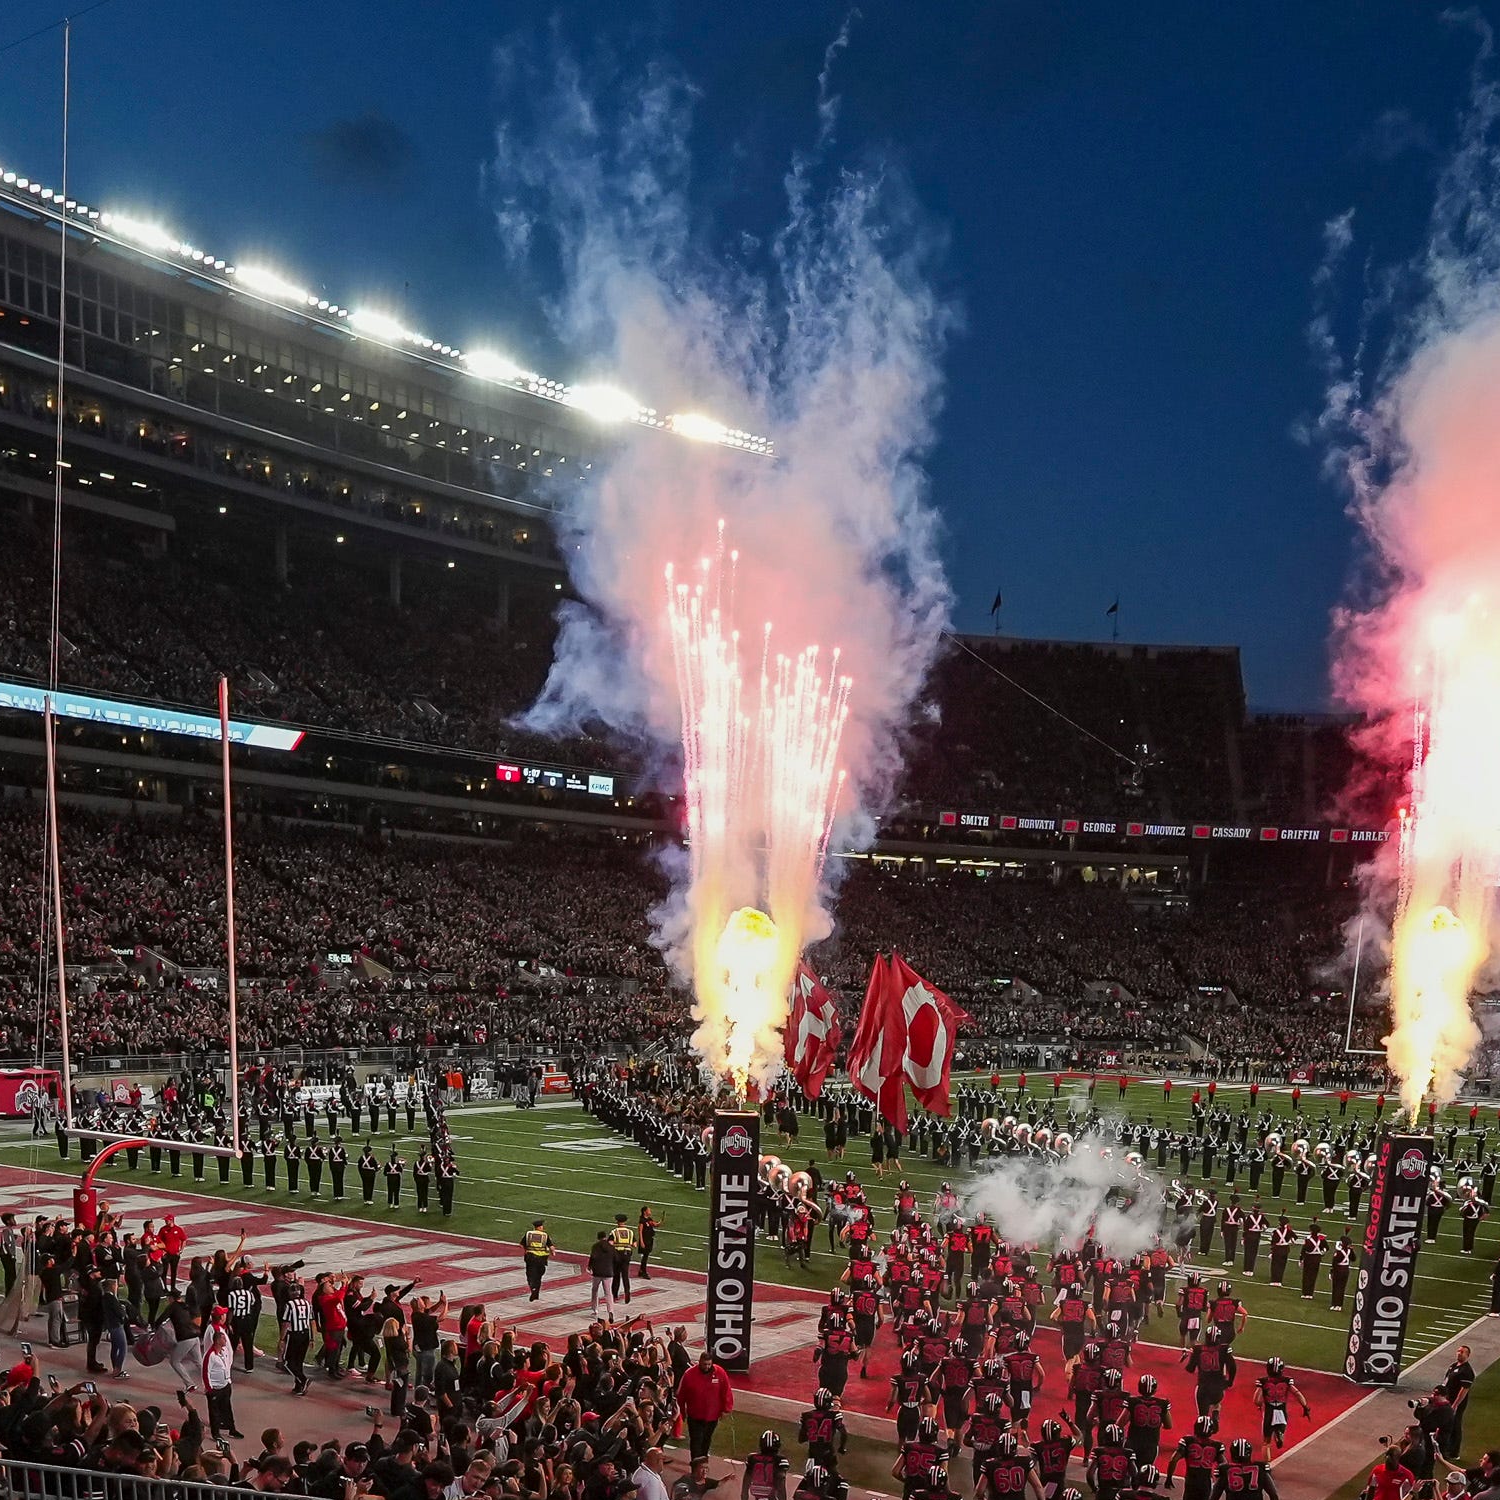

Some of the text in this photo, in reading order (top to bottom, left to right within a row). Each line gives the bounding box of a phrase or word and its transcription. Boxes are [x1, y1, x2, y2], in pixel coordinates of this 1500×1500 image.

[960, 815, 990, 827] SMITH
[1018, 818, 1055, 830] HORVATH
[1083, 822, 1117, 834] GEORGE
[1144, 824, 1186, 837] JANOWICZ
[1212, 828, 1251, 839] CASSADY
[1280, 830, 1320, 841] GRIFFIN
[1351, 831, 1391, 842] HARLEY
[713, 1174, 750, 1360] OHIO STATE
[1363, 1196, 1422, 1376] OHIO STATE
[239, 1295, 246, 1309] S
[904, 1381, 921, 1402] 7
[806, 1418, 833, 1442] 24
[1041, 1450, 1066, 1472] 13
[1100, 1455, 1128, 1480] 29
[994, 1467, 1025, 1493] 60
[1228, 1467, 1258, 1491] 67
